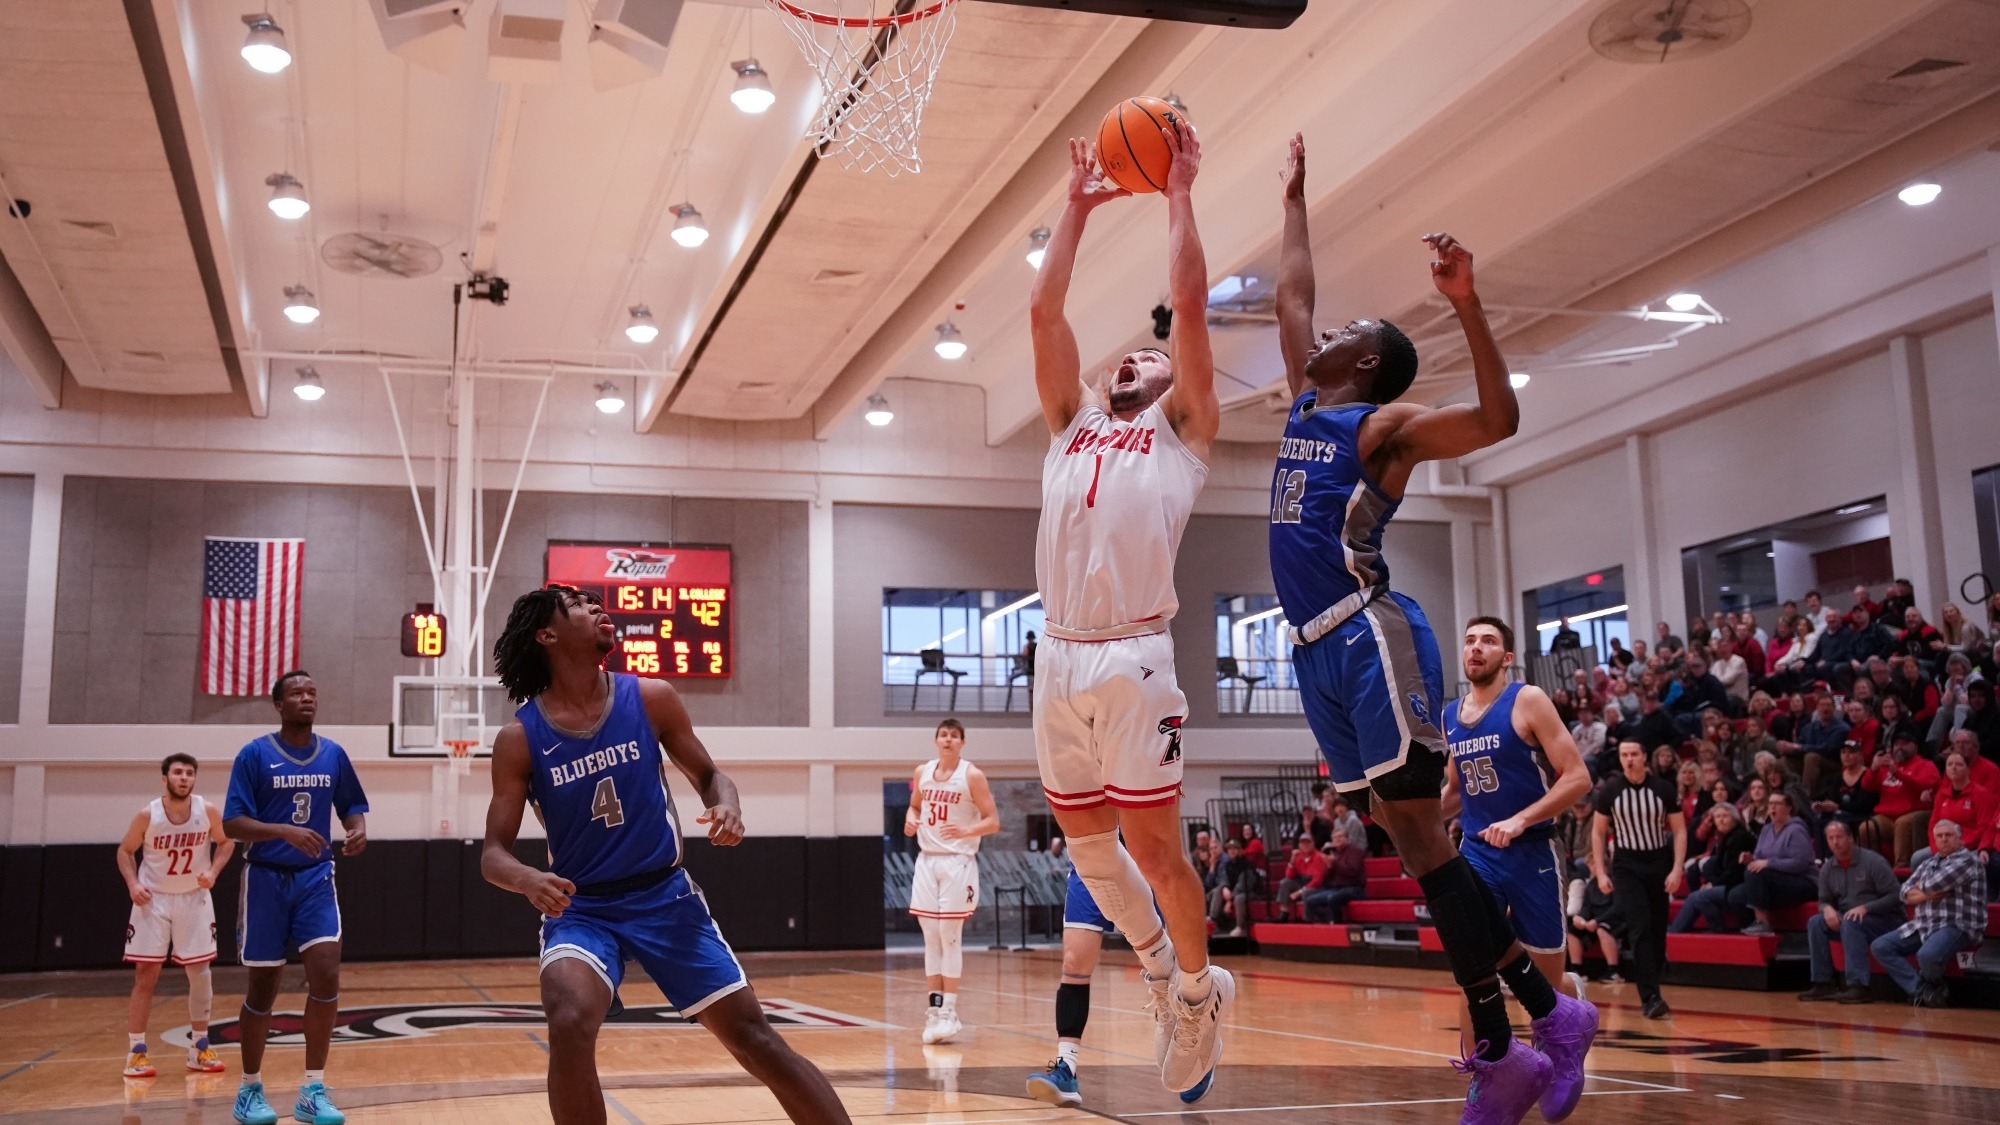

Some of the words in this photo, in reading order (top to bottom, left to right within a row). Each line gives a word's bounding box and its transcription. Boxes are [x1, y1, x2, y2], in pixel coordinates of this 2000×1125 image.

[1087, 454, 1102, 508] 1
[1271, 469, 1307, 524] 12
[612, 556, 668, 577] Ripon
[692, 602, 721, 626] 42
[417, 627, 442, 655] 18
[626, 623, 654, 636] period
[660, 619, 673, 638] 2
[676, 654, 688, 673] 5
[710, 655, 722, 673] 2
[550, 740, 640, 787] BLUEBOYS
[1460, 756, 1500, 796] 35
[273, 774, 331, 789] BLUEBOYS
[292, 792, 312, 824] 3
[591, 776, 625, 828] 4
[928, 803, 948, 826] 34
[153, 834, 172, 850] RED
[173, 831, 207, 848] HAWKS
[166, 848, 193, 876] 22
